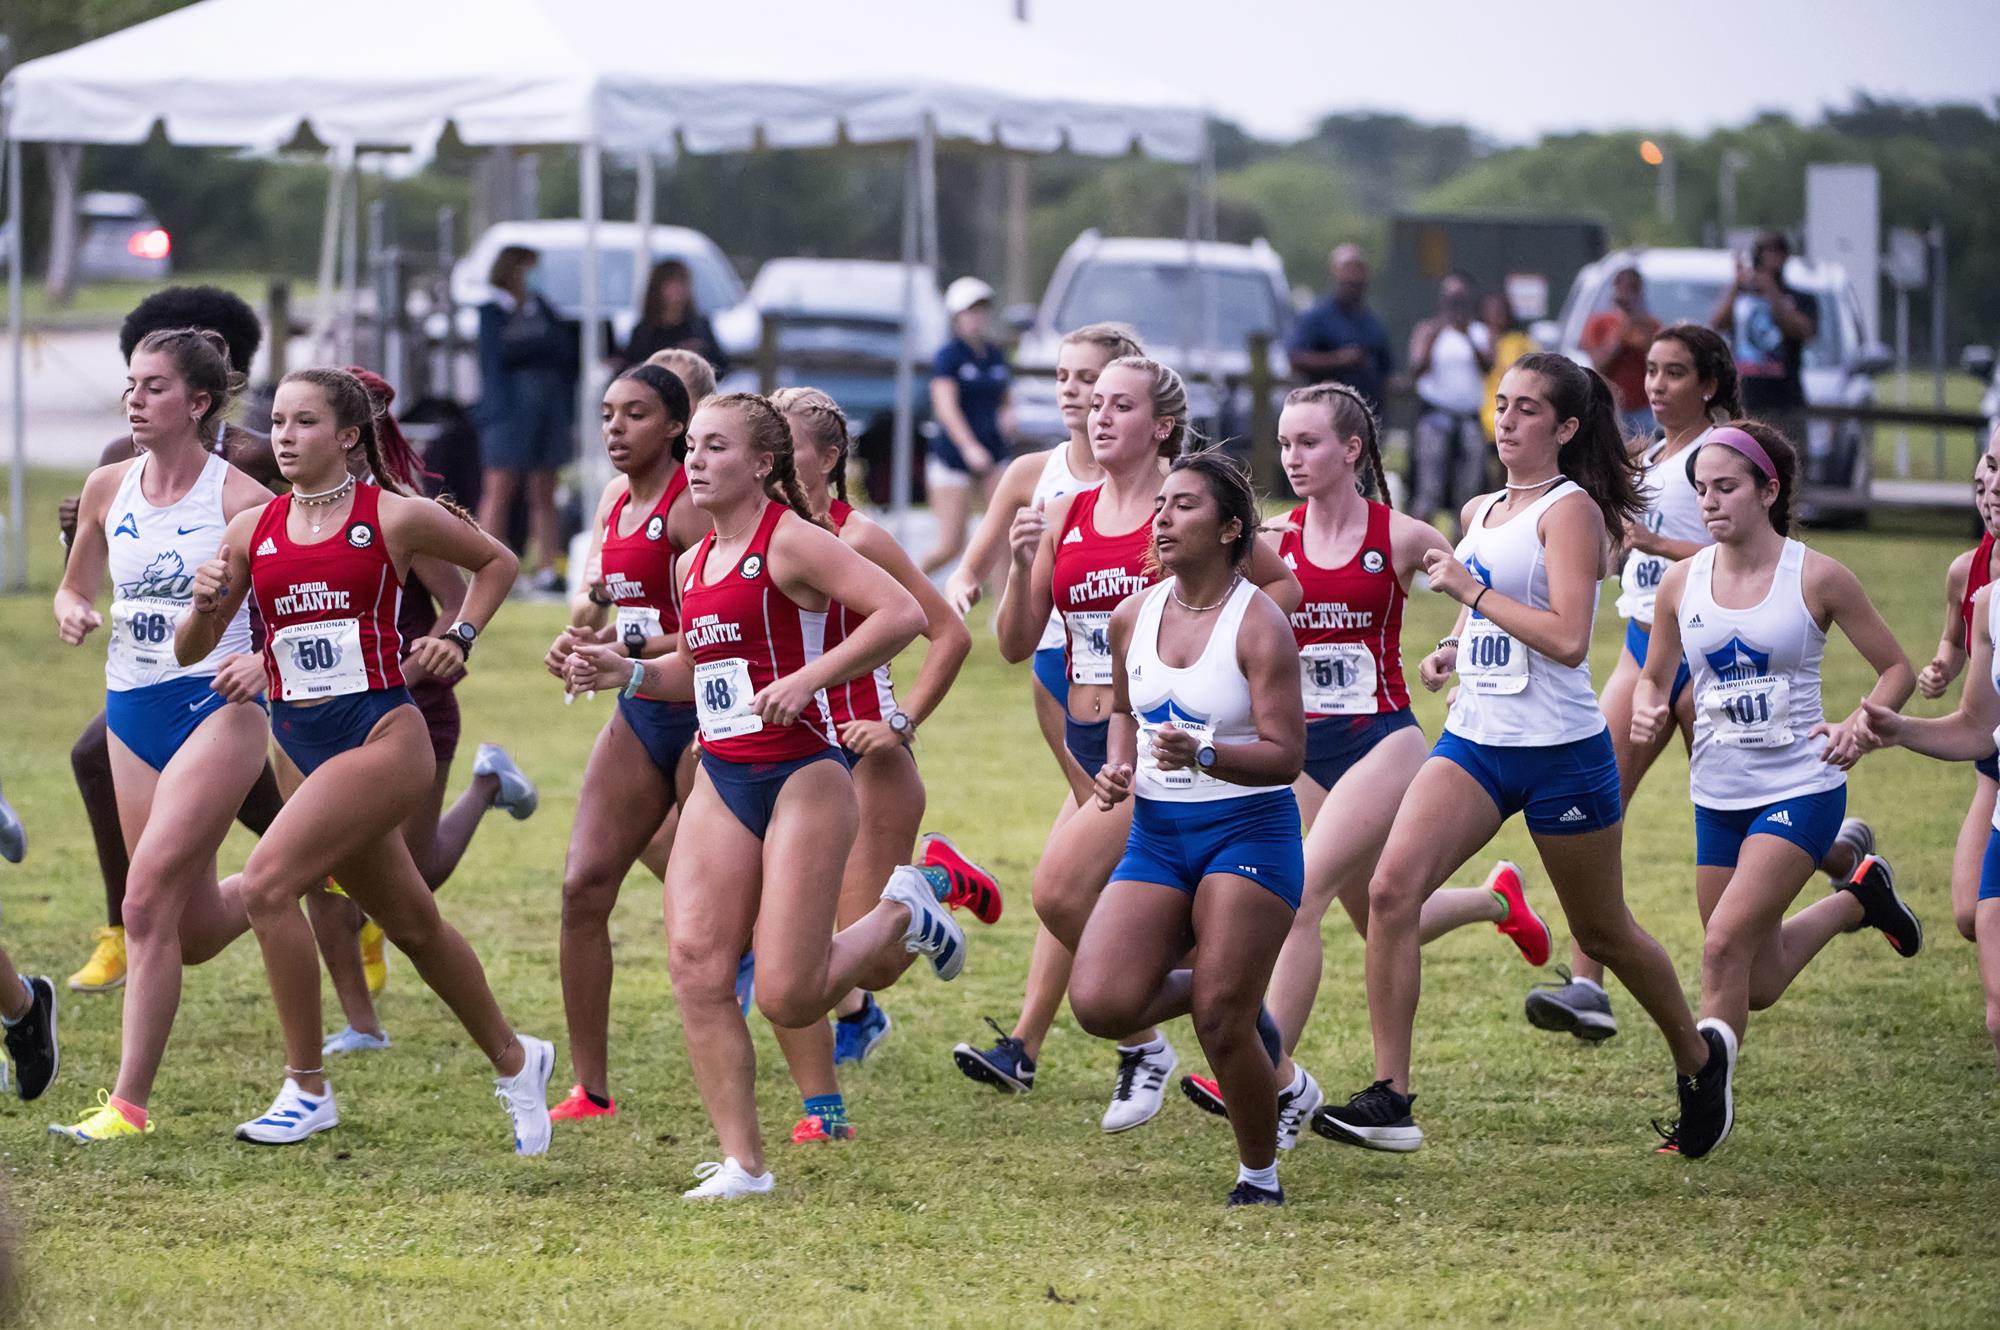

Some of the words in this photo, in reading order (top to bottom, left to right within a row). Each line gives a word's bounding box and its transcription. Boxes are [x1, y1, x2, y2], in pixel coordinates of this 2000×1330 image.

[288, 581, 329, 595] FLORIDA
[1086, 567, 1126, 583] FLORIDA
[1636, 560, 1660, 588] 62
[274, 591, 350, 616] ATLANTIC
[1069, 576, 1149, 605] ATLANTIC
[692, 613, 720, 629] FLORIDA
[1290, 611, 1373, 629] ATLANTIC
[1305, 602, 1349, 613] FLORIDA
[132, 611, 167, 643] 66
[294, 620, 348, 633] INVITATIONAL
[685, 622, 742, 651] ATLANTIC
[298, 638, 334, 671] 50
[1471, 635, 1511, 667] 100
[1314, 659, 1346, 688] 51
[1726, 676, 1778, 689] INVITATIONAL
[706, 678, 731, 711] 48
[1721, 692, 1769, 724] 101
